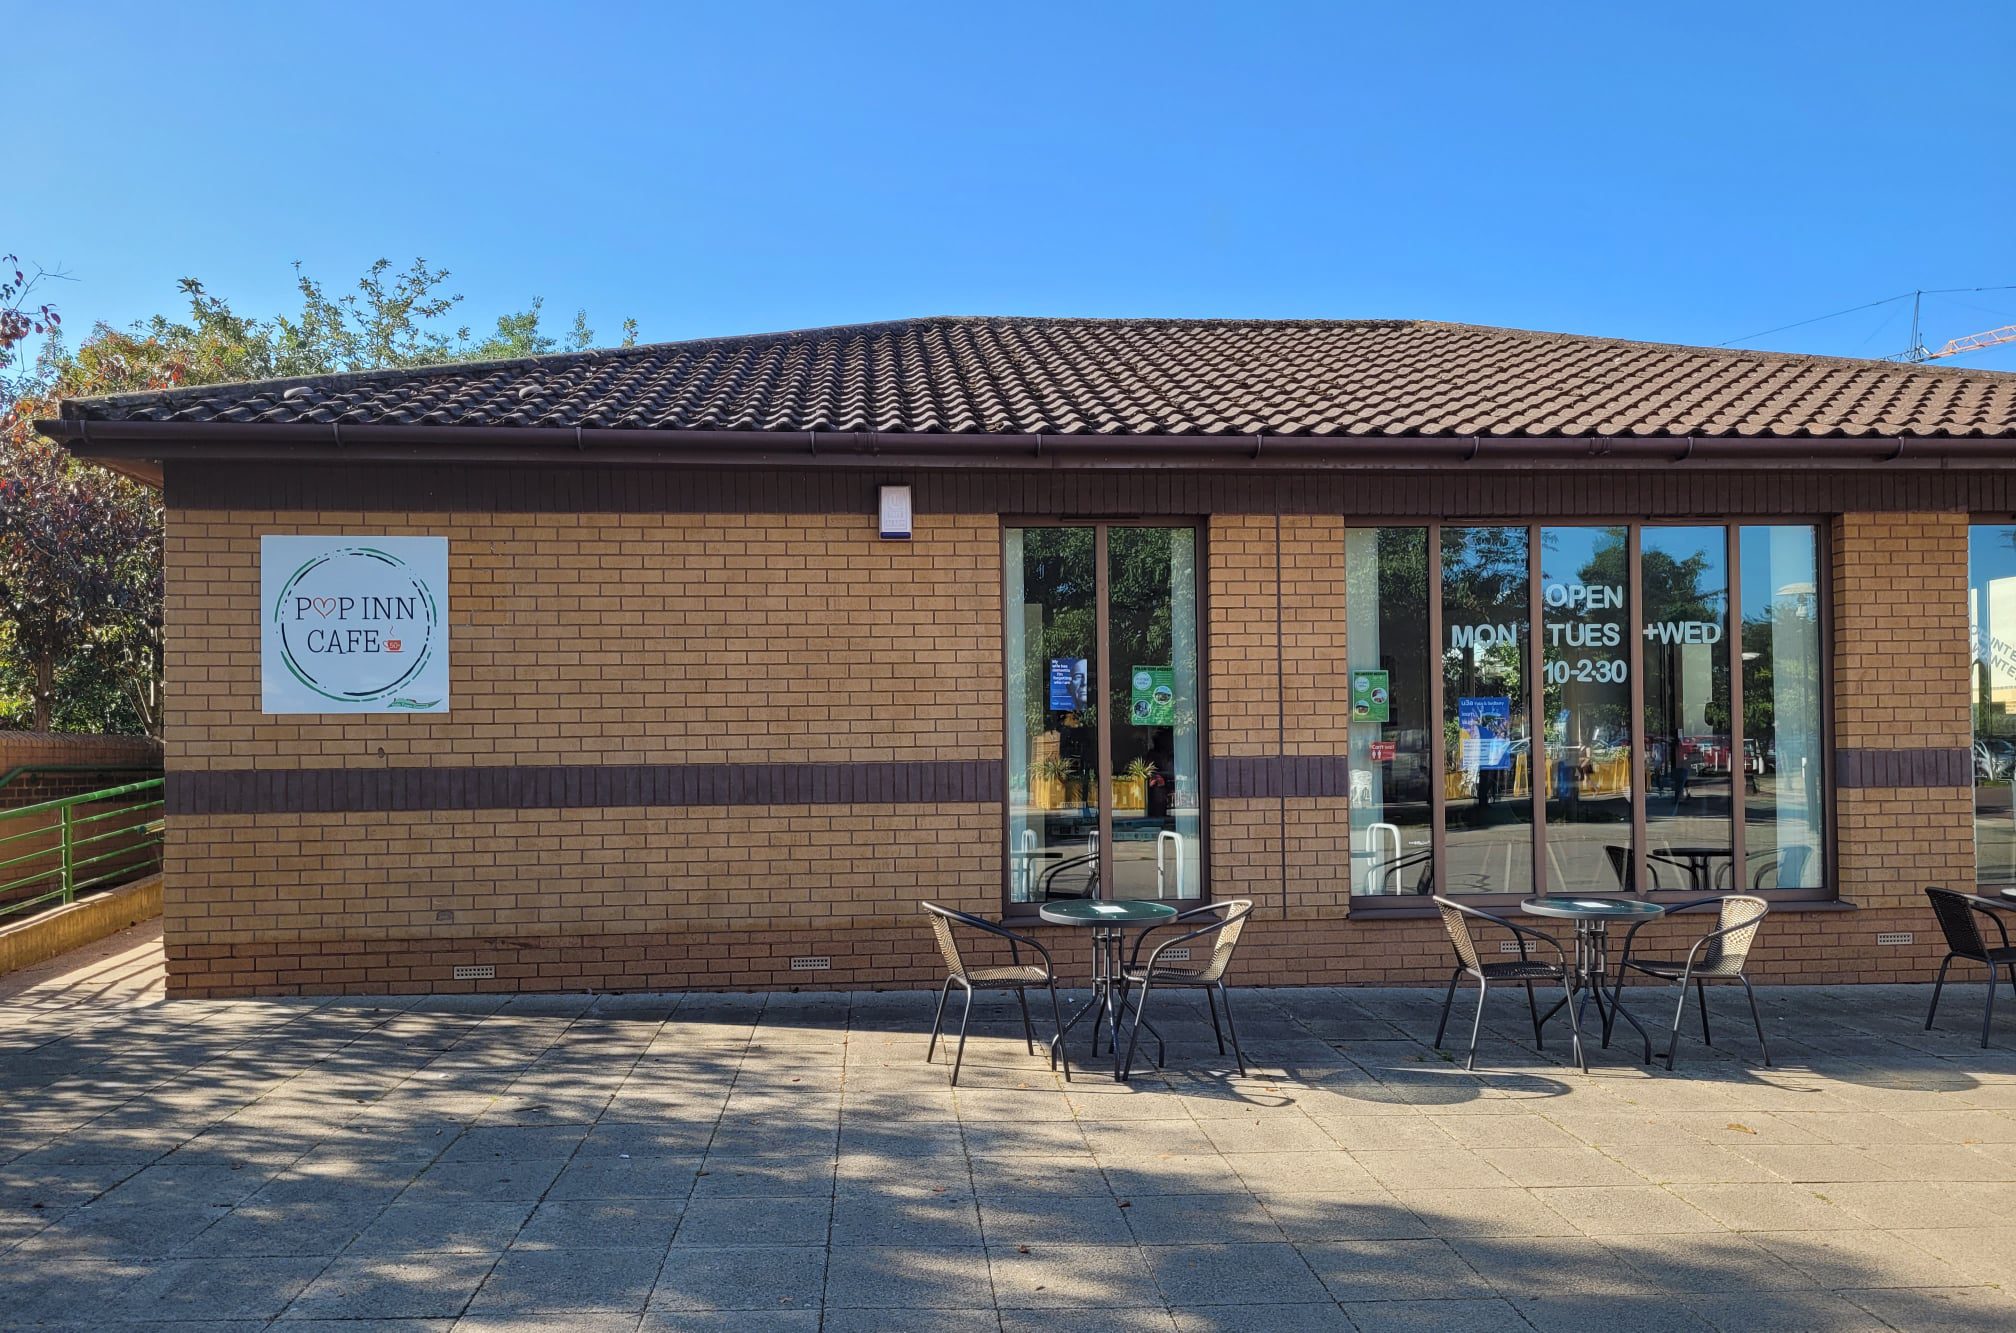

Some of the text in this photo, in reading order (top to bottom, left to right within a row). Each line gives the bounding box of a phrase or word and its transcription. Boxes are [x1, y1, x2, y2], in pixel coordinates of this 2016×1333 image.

[361, 596, 417, 620] INN
[1545, 583, 1624, 609] OPEN
[307, 629, 381, 655] CAFE
[1451, 623, 1518, 649] MON
[1546, 622, 1621, 647] TUES
